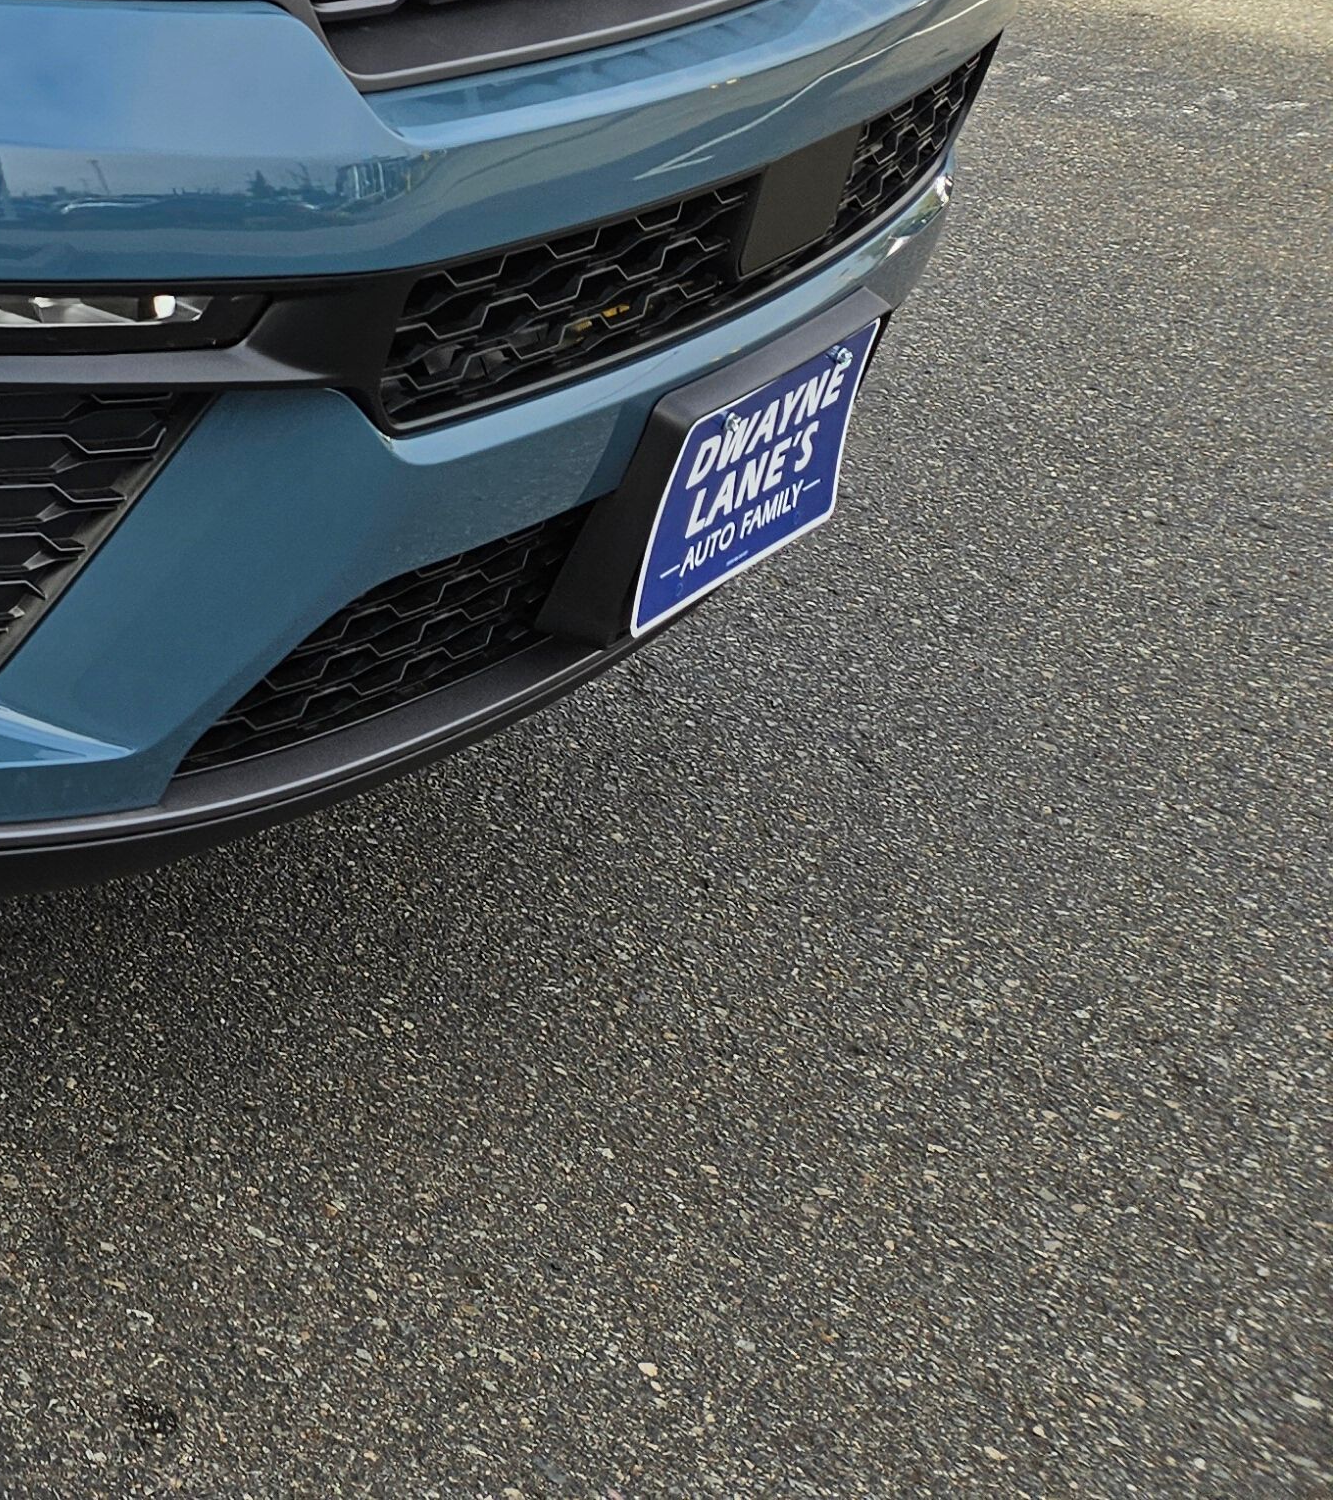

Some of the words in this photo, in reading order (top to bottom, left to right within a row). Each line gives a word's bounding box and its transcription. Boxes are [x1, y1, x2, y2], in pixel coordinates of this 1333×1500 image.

[685, 421, 820, 539] LANE'S
[686, 364, 849, 490] DWAYNE
[679, 521, 735, 578] AUTO
[739, 479, 805, 540] FAMILY
